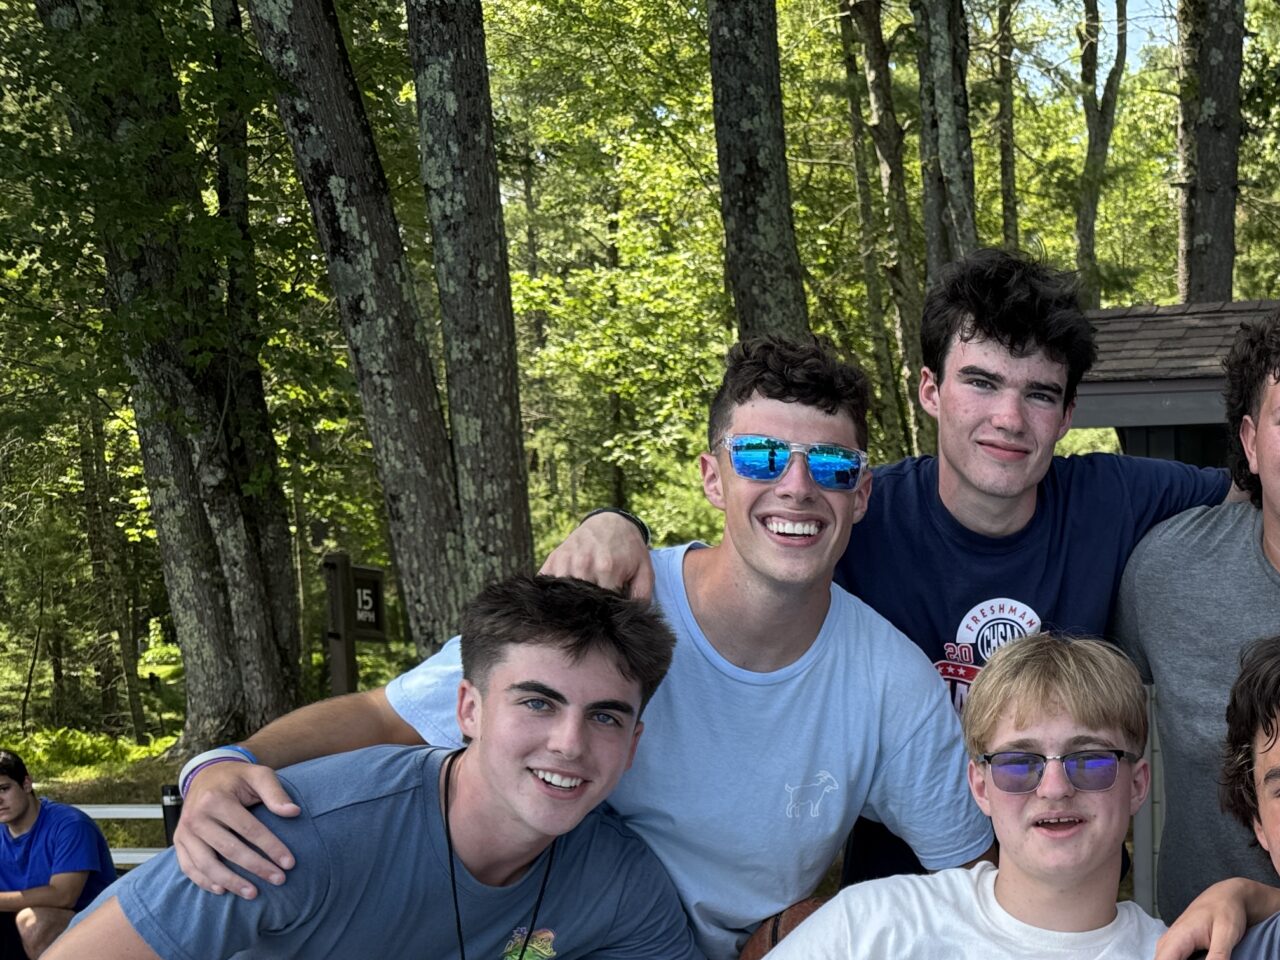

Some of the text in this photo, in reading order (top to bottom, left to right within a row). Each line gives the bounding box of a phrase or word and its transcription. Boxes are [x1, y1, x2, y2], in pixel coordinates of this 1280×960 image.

[356, 588, 373, 610] 15
[356, 610, 375, 623] MPH
[966, 603, 1036, 632] FRESHMAN
[944, 642, 975, 664] 20
